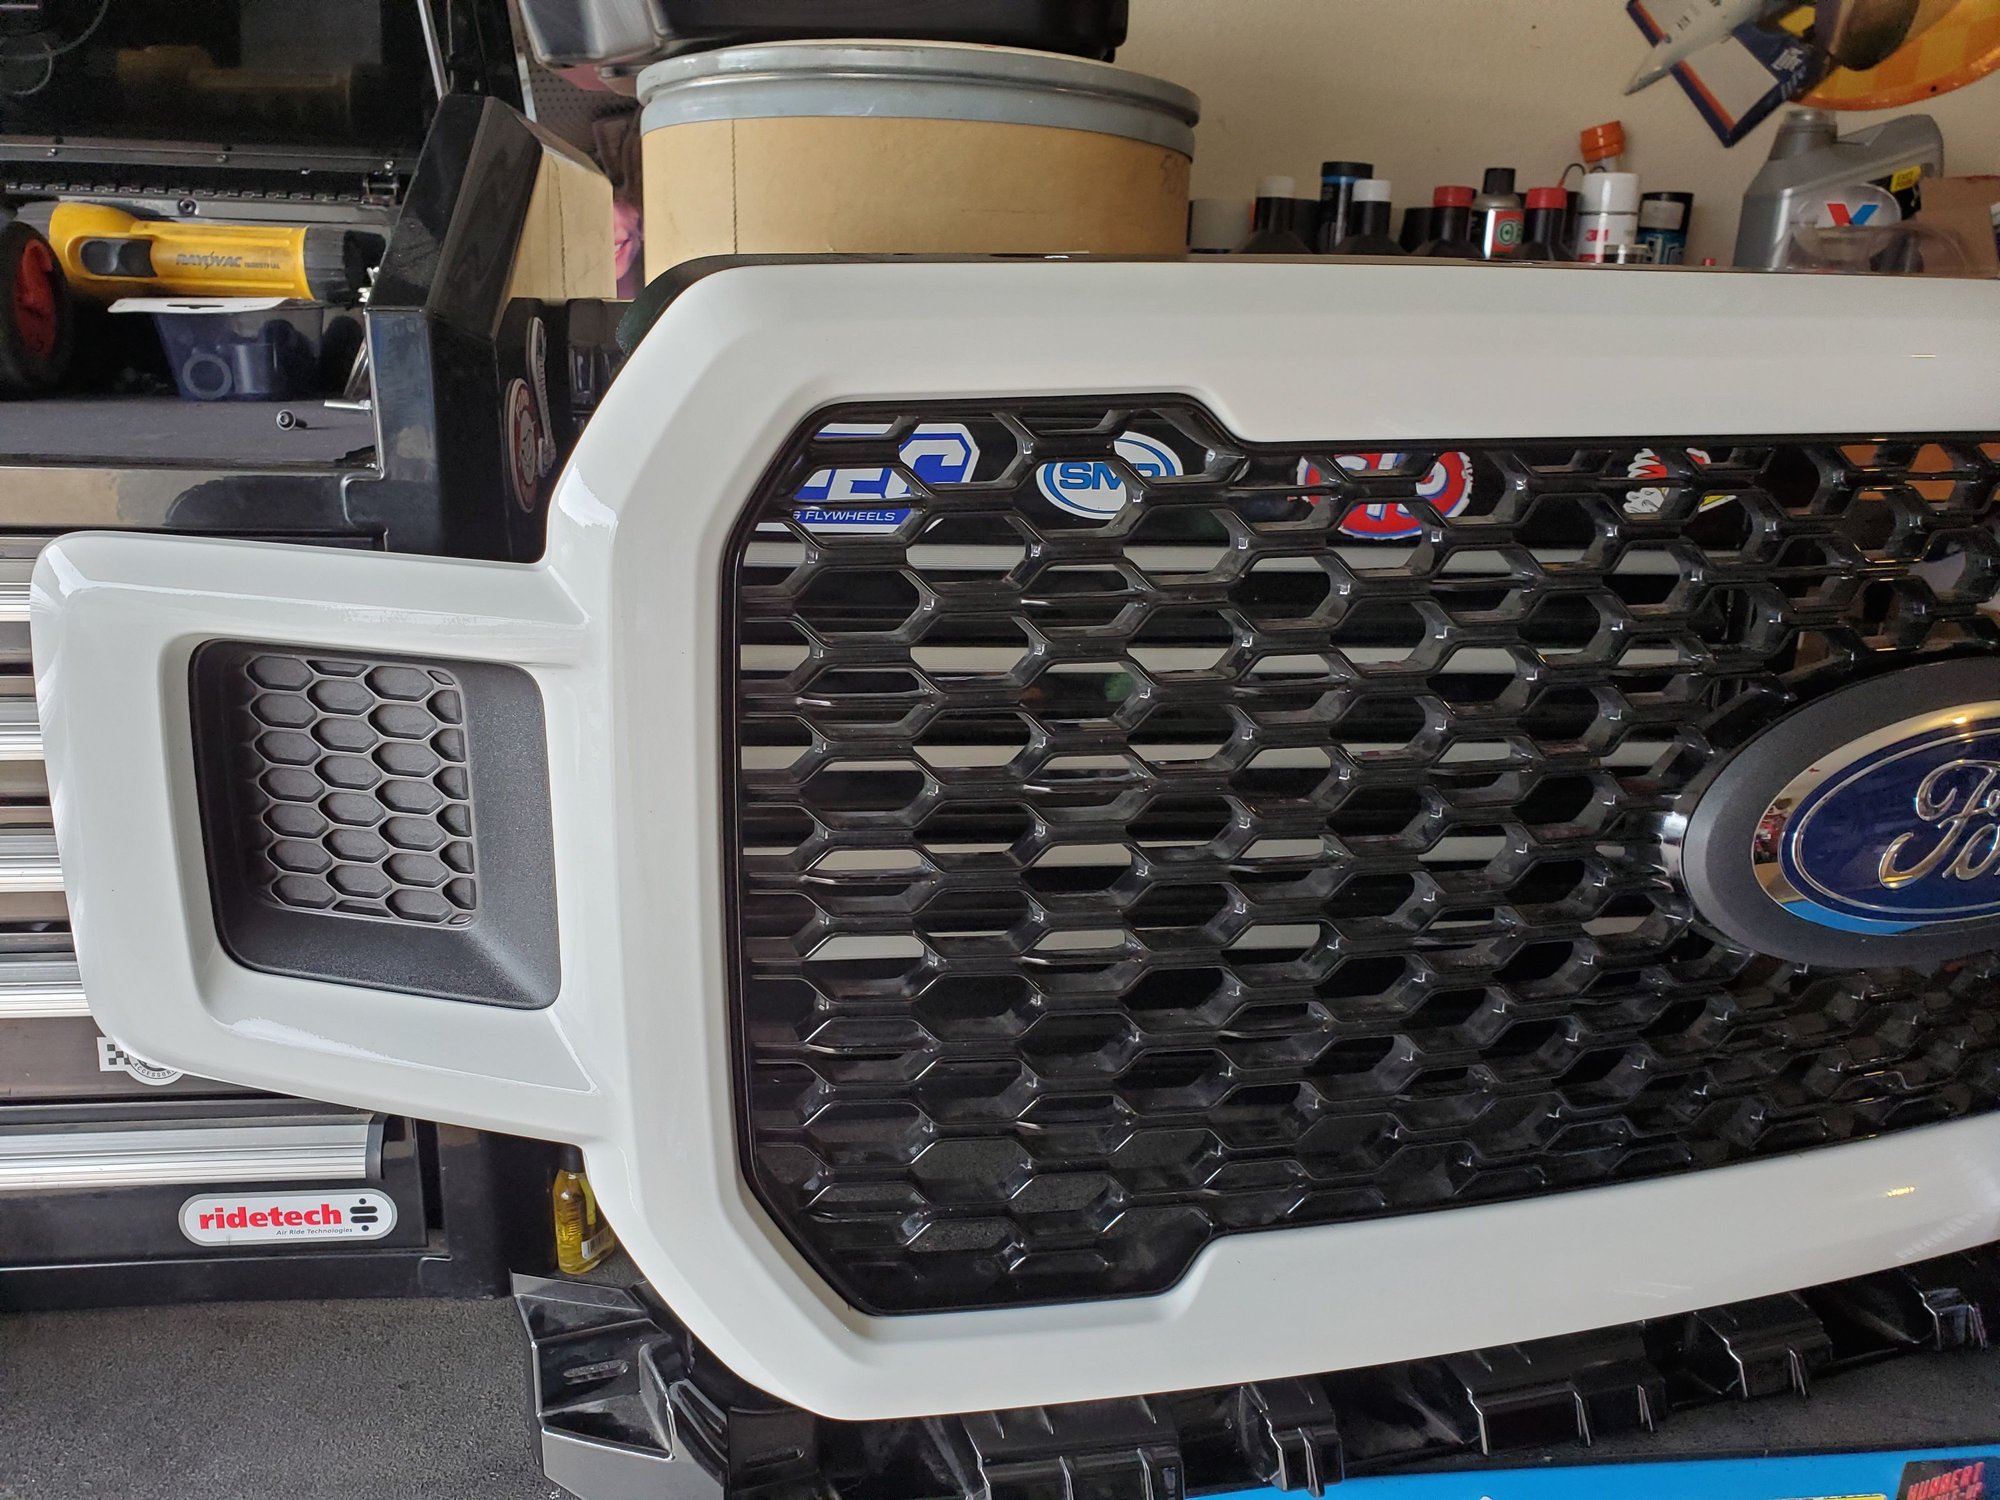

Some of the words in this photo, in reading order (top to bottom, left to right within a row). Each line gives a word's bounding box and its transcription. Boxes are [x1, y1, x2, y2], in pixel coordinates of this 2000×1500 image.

[176, 252, 242, 269] RAYOVAC
[805, 511, 896, 522] FLYWHEELS
[1878, 759, 2000, 889] Fo
[199, 1204, 342, 1230] ridetech
[307, 1228, 353, 1236] Technologies
